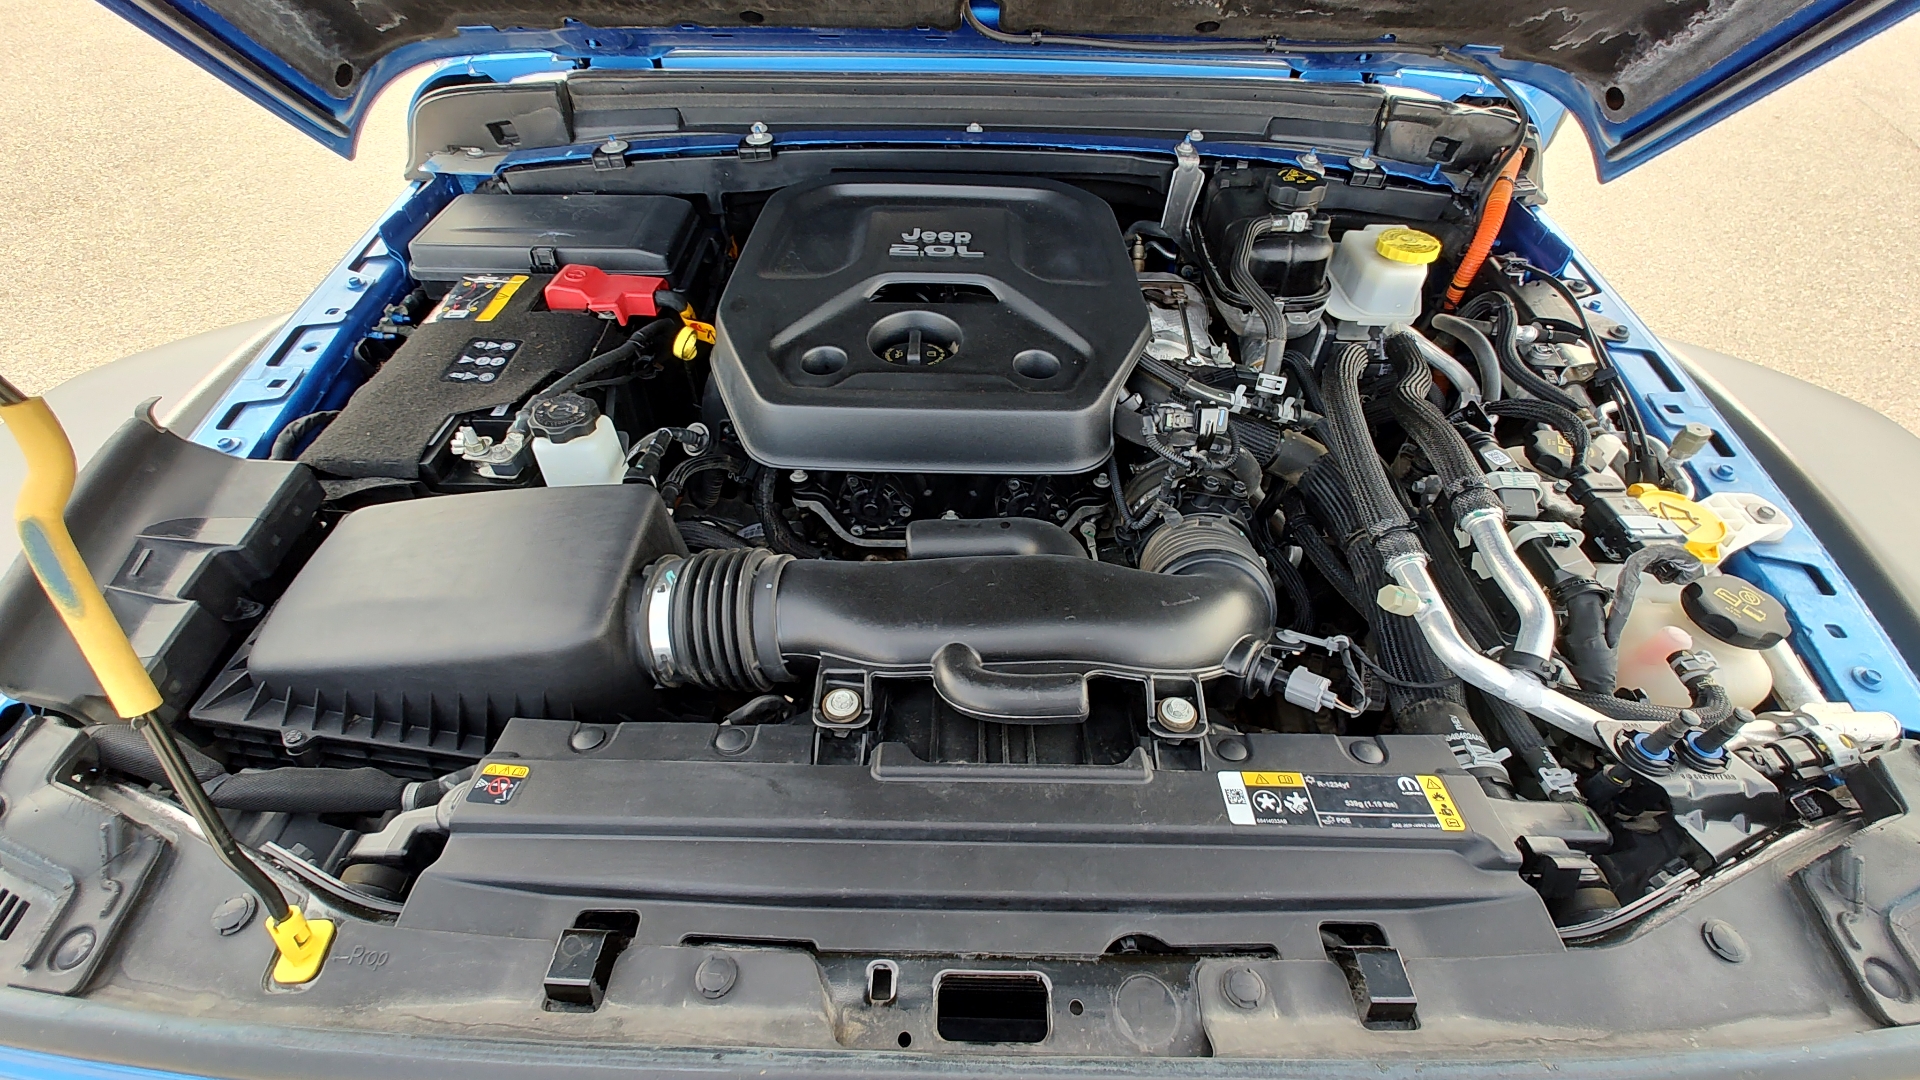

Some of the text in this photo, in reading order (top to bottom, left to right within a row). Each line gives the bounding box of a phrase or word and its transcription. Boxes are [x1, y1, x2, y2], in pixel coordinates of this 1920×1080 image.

[901, 227, 972, 245] Jeep
[888, 243, 985, 258] 2.0L
[347, 944, 390, 972] Prop
